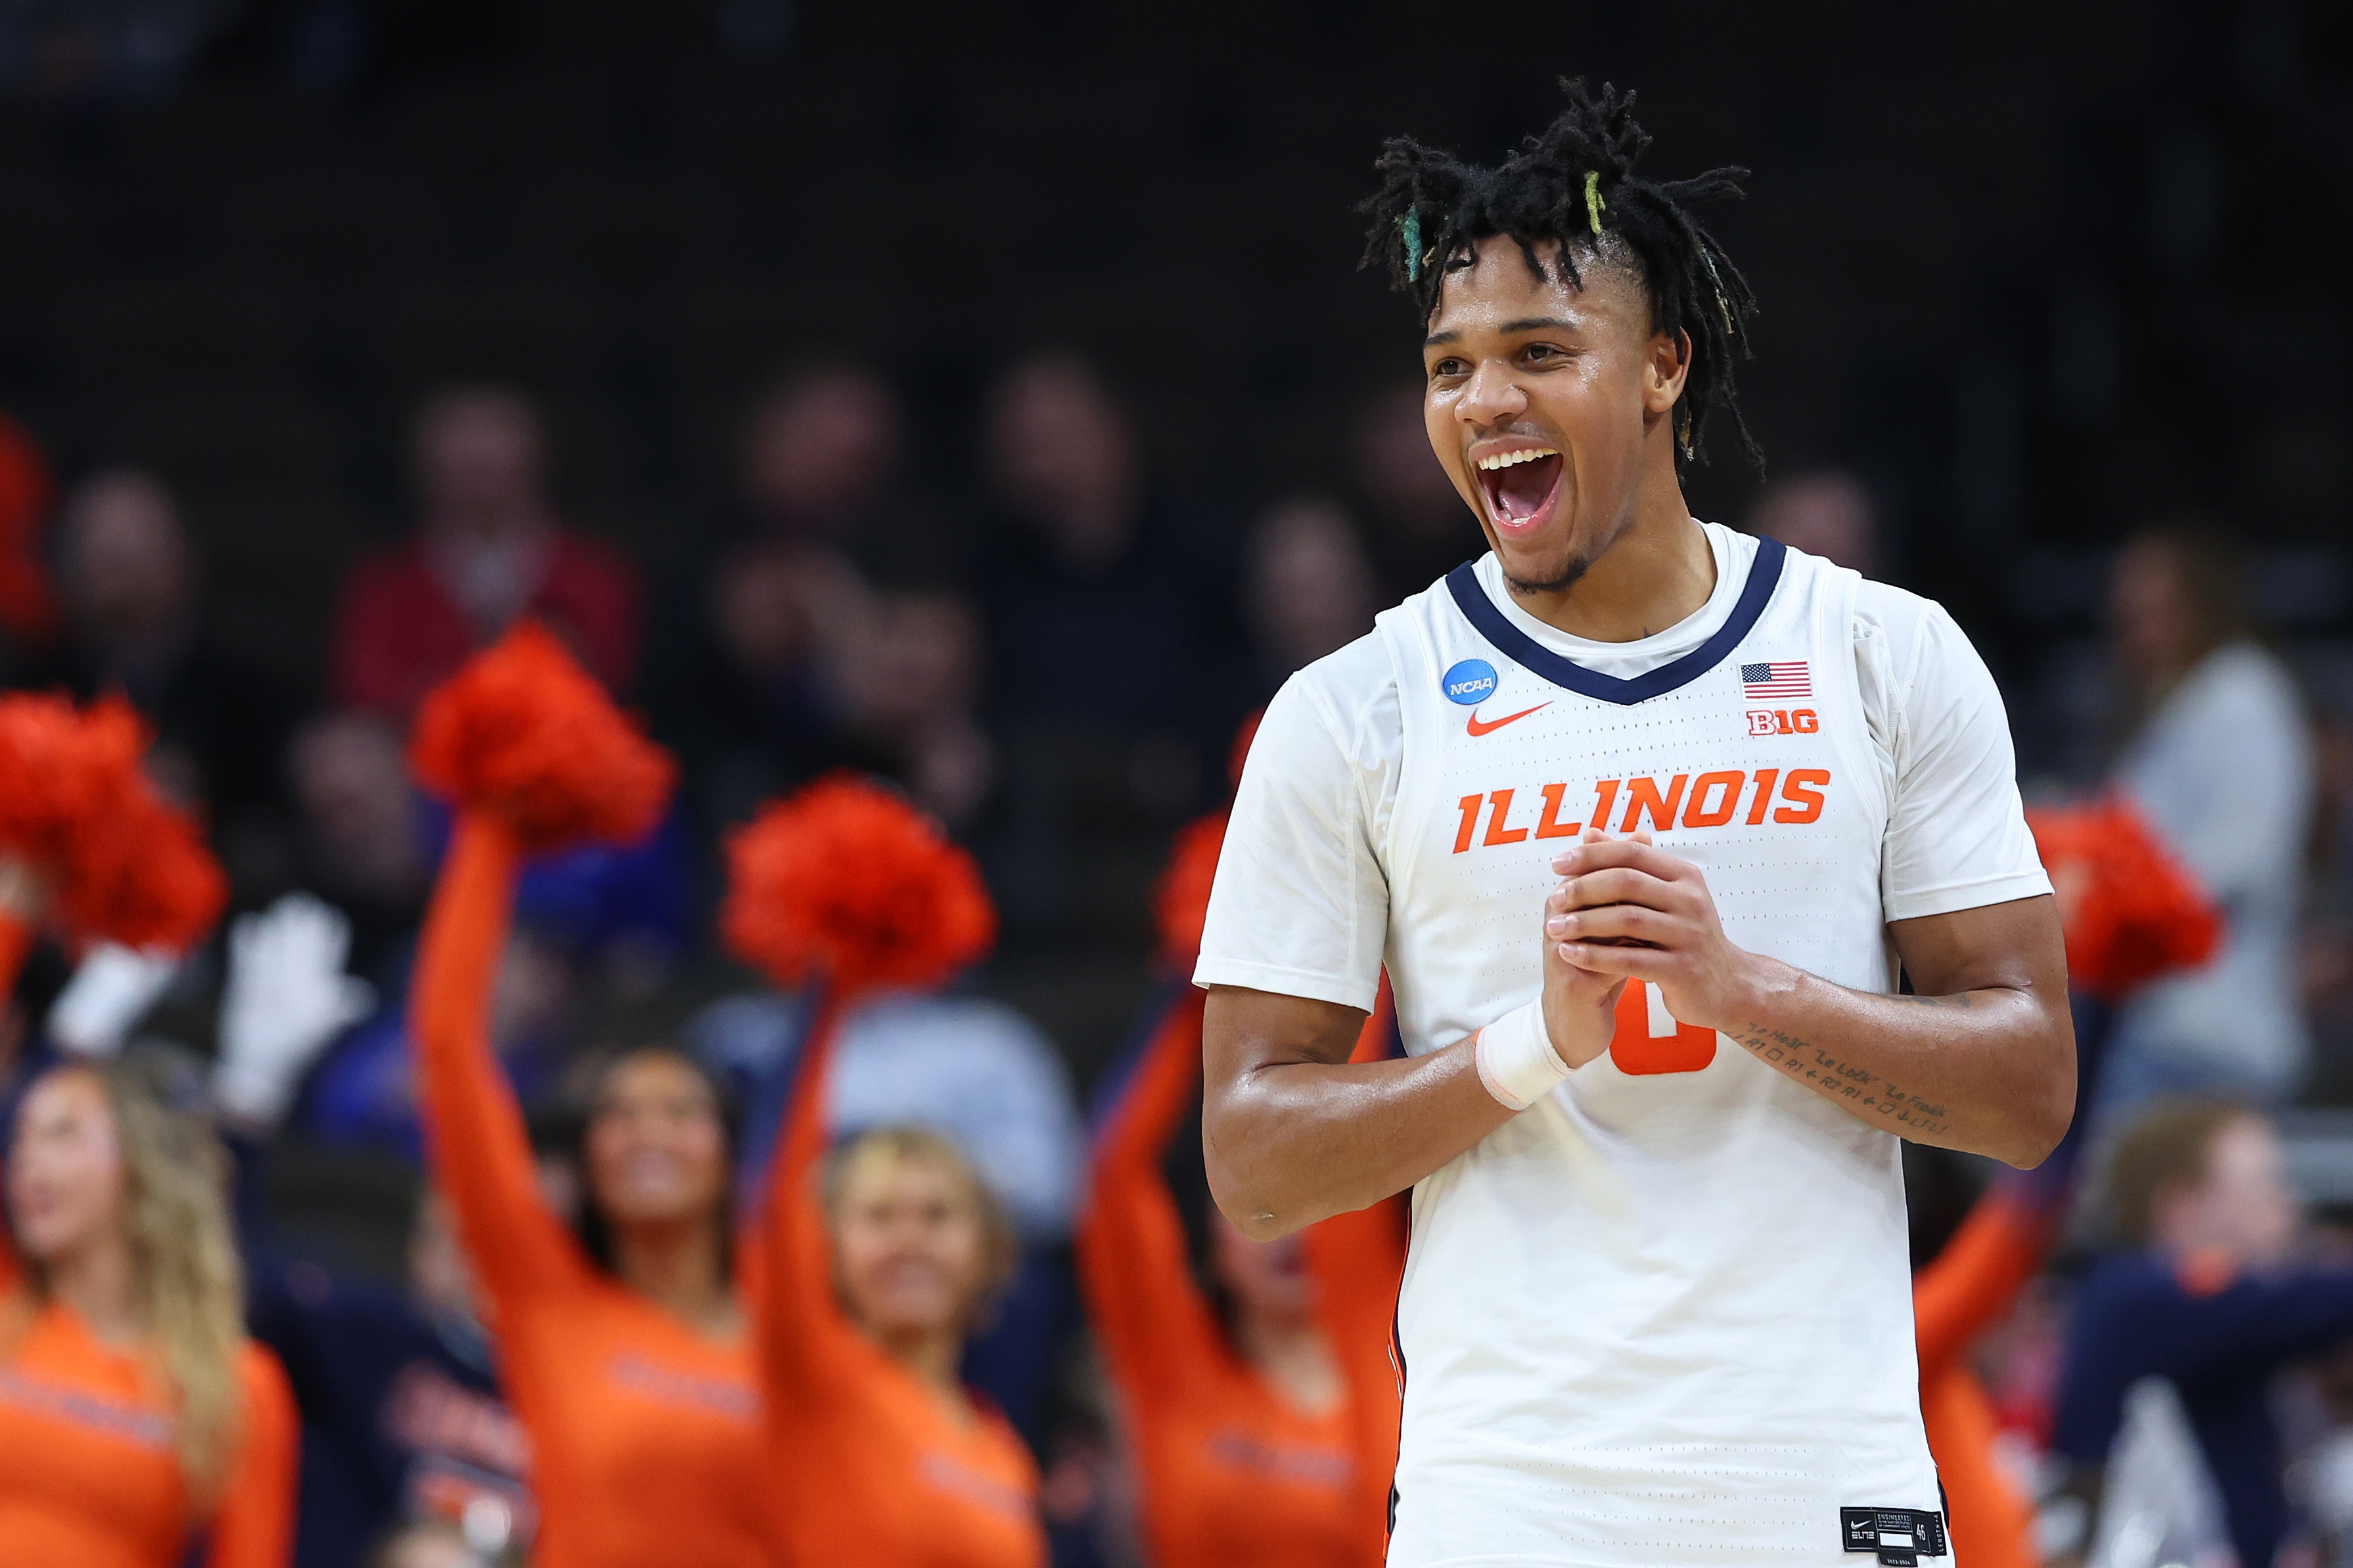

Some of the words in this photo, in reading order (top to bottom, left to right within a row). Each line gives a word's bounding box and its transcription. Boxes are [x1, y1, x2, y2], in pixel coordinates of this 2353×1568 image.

[1450, 677, 1493, 696] NCAA
[1452, 768, 1831, 853] ILLINOIS
[1916, 1523, 1926, 1541] 46
